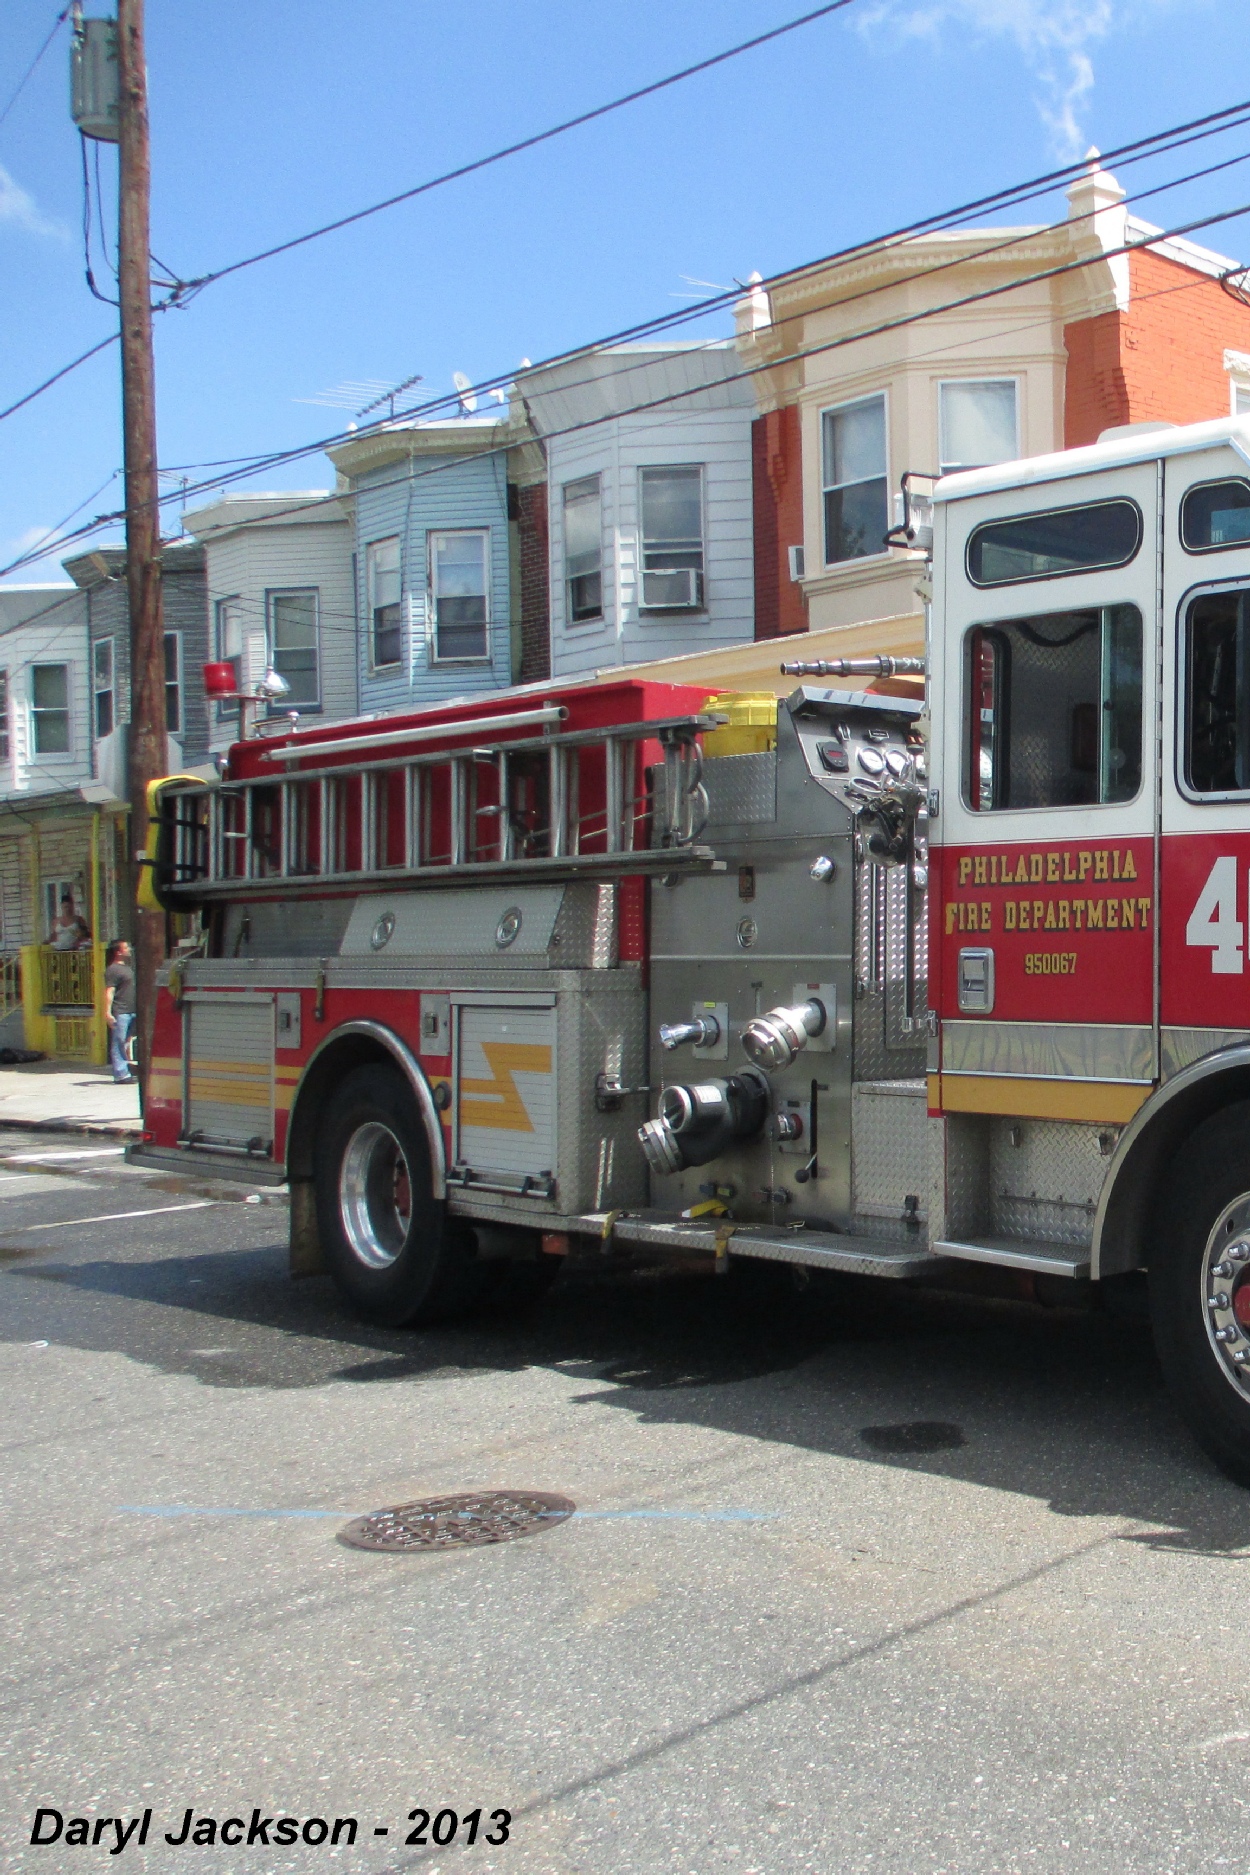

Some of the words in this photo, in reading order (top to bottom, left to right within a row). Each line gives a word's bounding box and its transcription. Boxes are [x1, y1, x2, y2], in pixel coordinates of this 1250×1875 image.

[958, 850, 1138, 885] PHILADELPHIA
[945, 902, 992, 935] FIRE
[1004, 897, 1150, 932] DEPARTMENT
[1024, 952, 1078, 975] 950067
